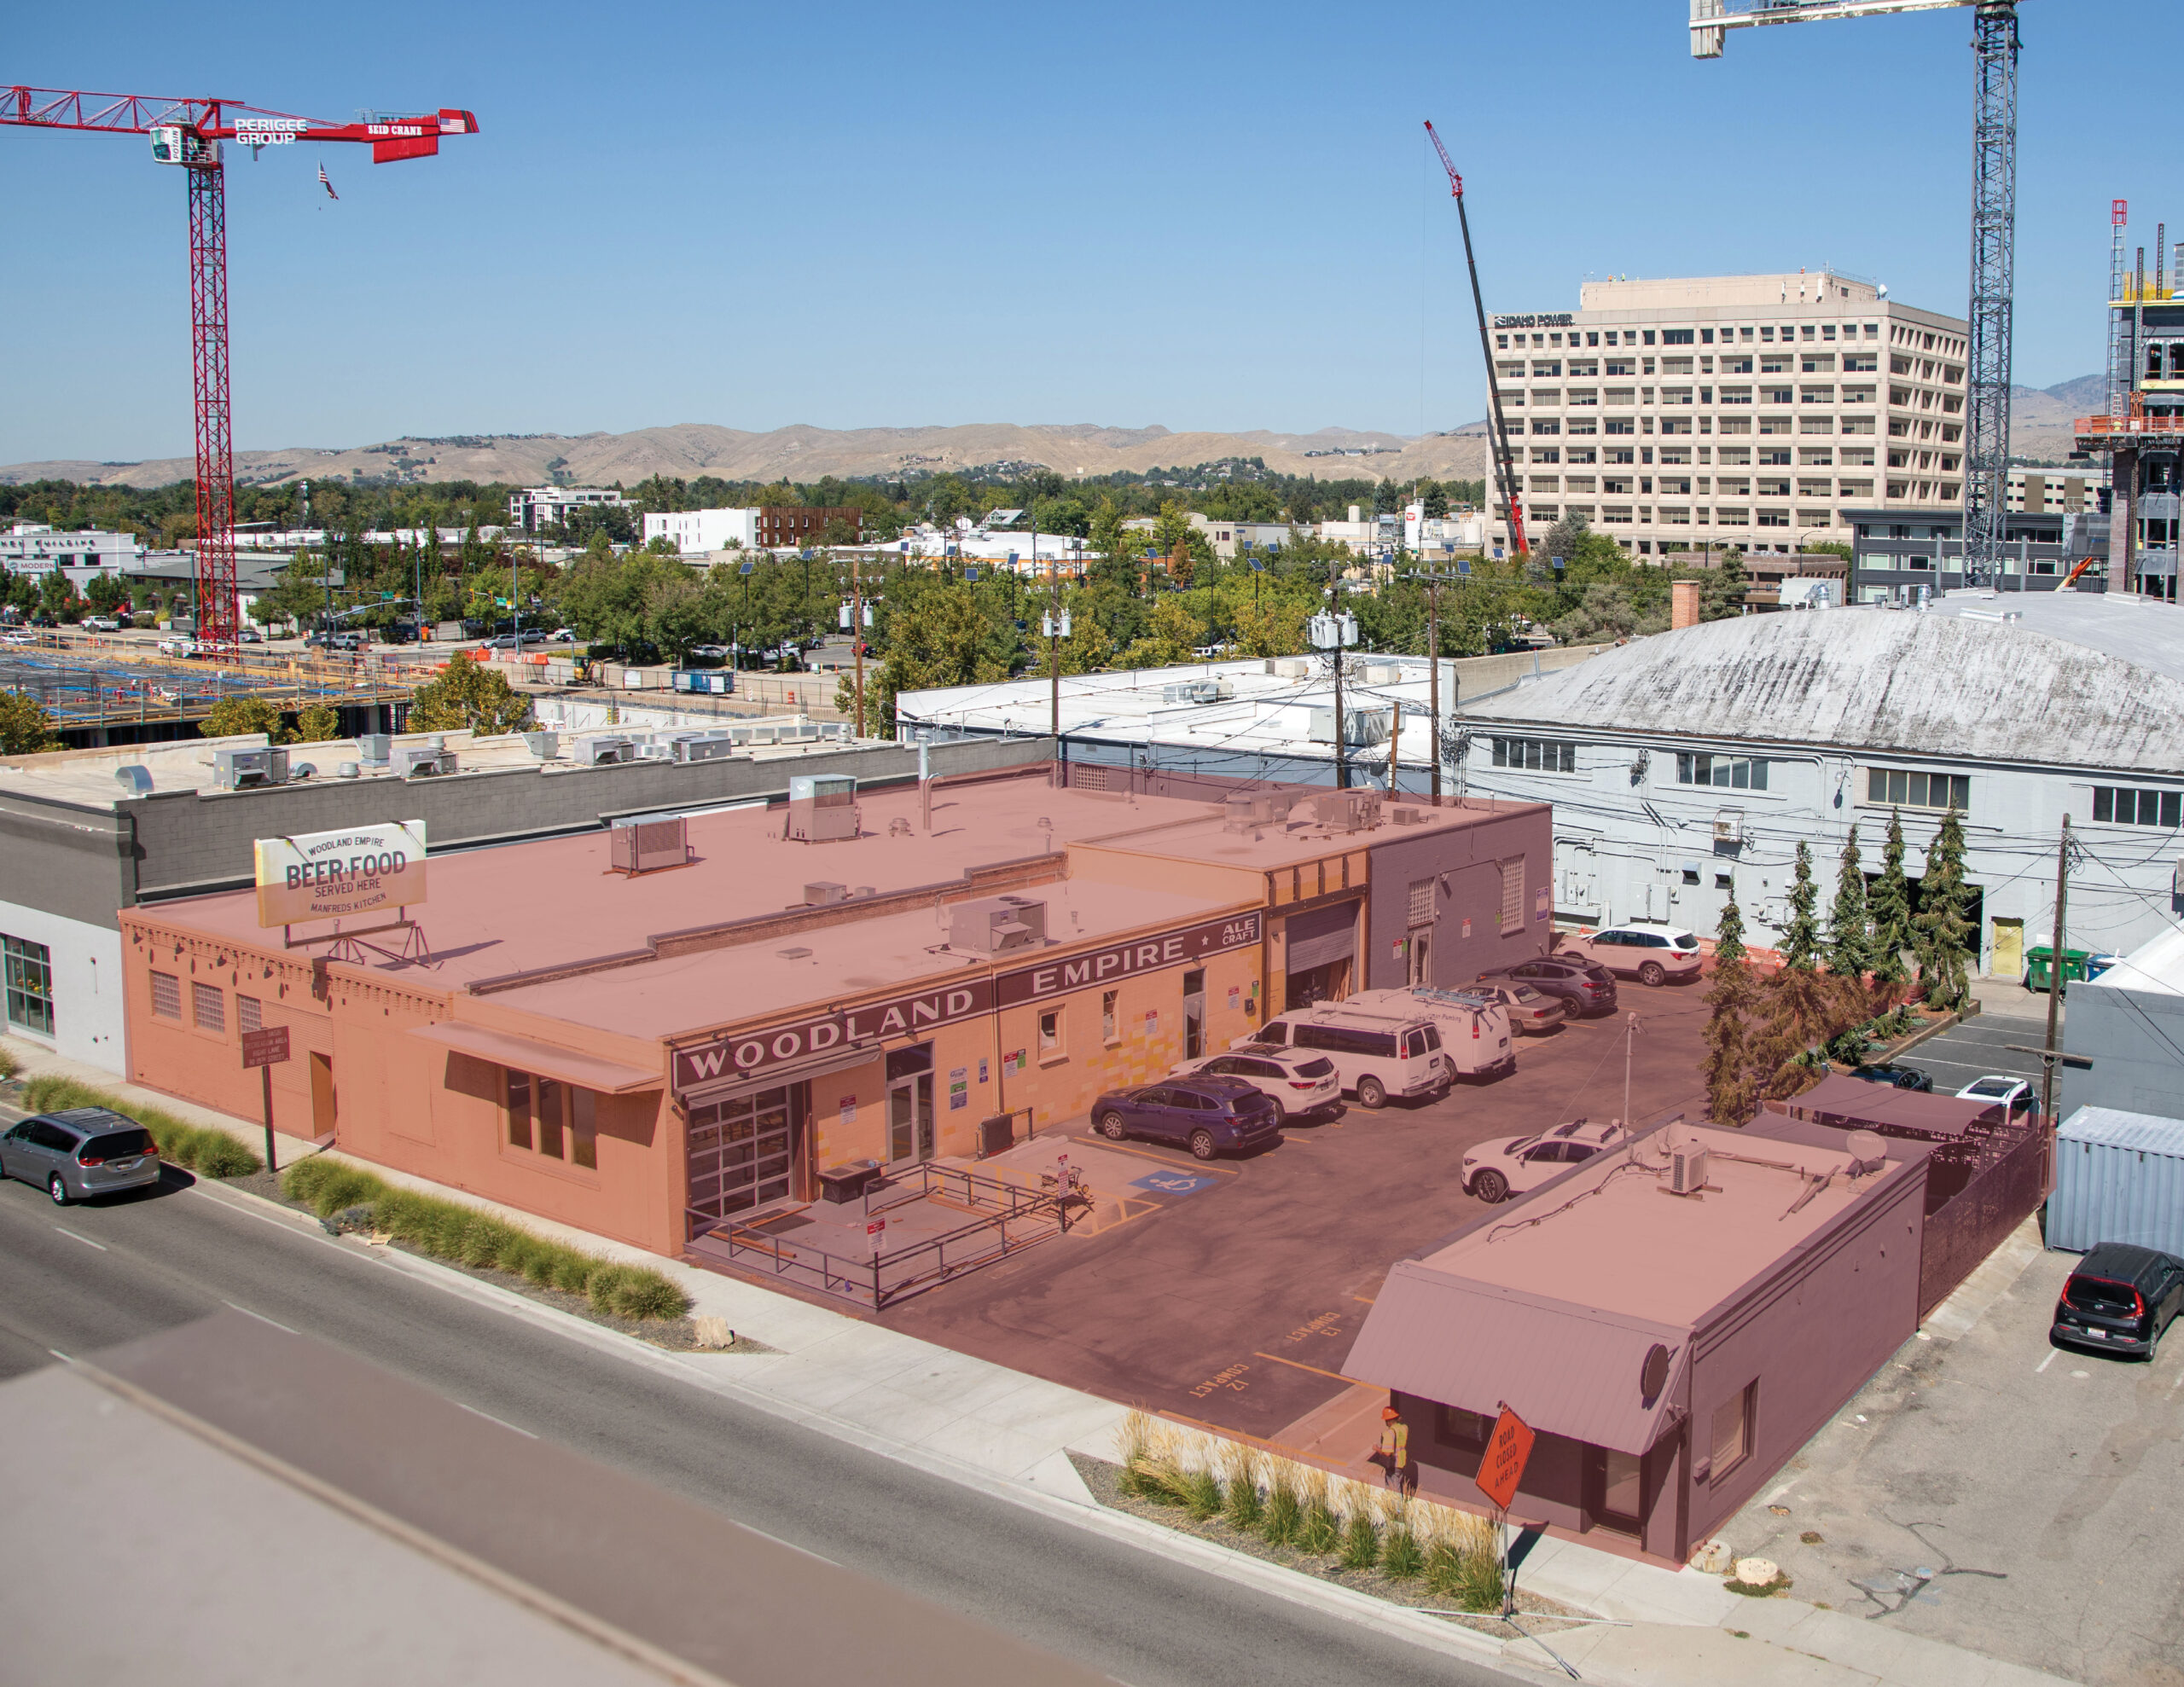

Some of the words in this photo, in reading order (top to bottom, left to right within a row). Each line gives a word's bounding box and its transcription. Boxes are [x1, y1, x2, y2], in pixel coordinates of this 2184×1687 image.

[235, 119, 307, 132] PERIGEE
[368, 125, 389, 135] SEID
[391, 125, 422, 136] CRANE
[236, 132, 297, 145] GROUP
[1506, 315, 1535, 328] IDAHO
[1537, 314, 1573, 328] POWER
[308, 838, 352, 856] WOODLAND
[355, 837, 385, 848] EMPIRE
[287, 859, 344, 890] BEER
[350, 851, 406, 880] FOOD
[315, 882, 353, 898] SERVED
[357, 878, 381, 891] HERE
[311, 902, 351, 913] MANFREDS
[354, 893, 386, 909] KITCHEN
[1223, 919, 1255, 936] ALE
[1223, 930, 1255, 945] CRAFT
[689, 989, 973, 1080] WOODLAND
[1033, 936, 1184, 994] EMPIRE
[1286, 1312, 1341, 1342] COMPACT
[1320, 1326, 1342, 1336] 13
[1188, 1364, 1250, 1398] COMPACT
[1226, 1379, 1250, 1391] 12
[1499, 1425, 1515, 1448] ROAD
[1496, 1446, 1517, 1469] CLOSED
[1495, 1462, 1519, 1489] AHEAD
